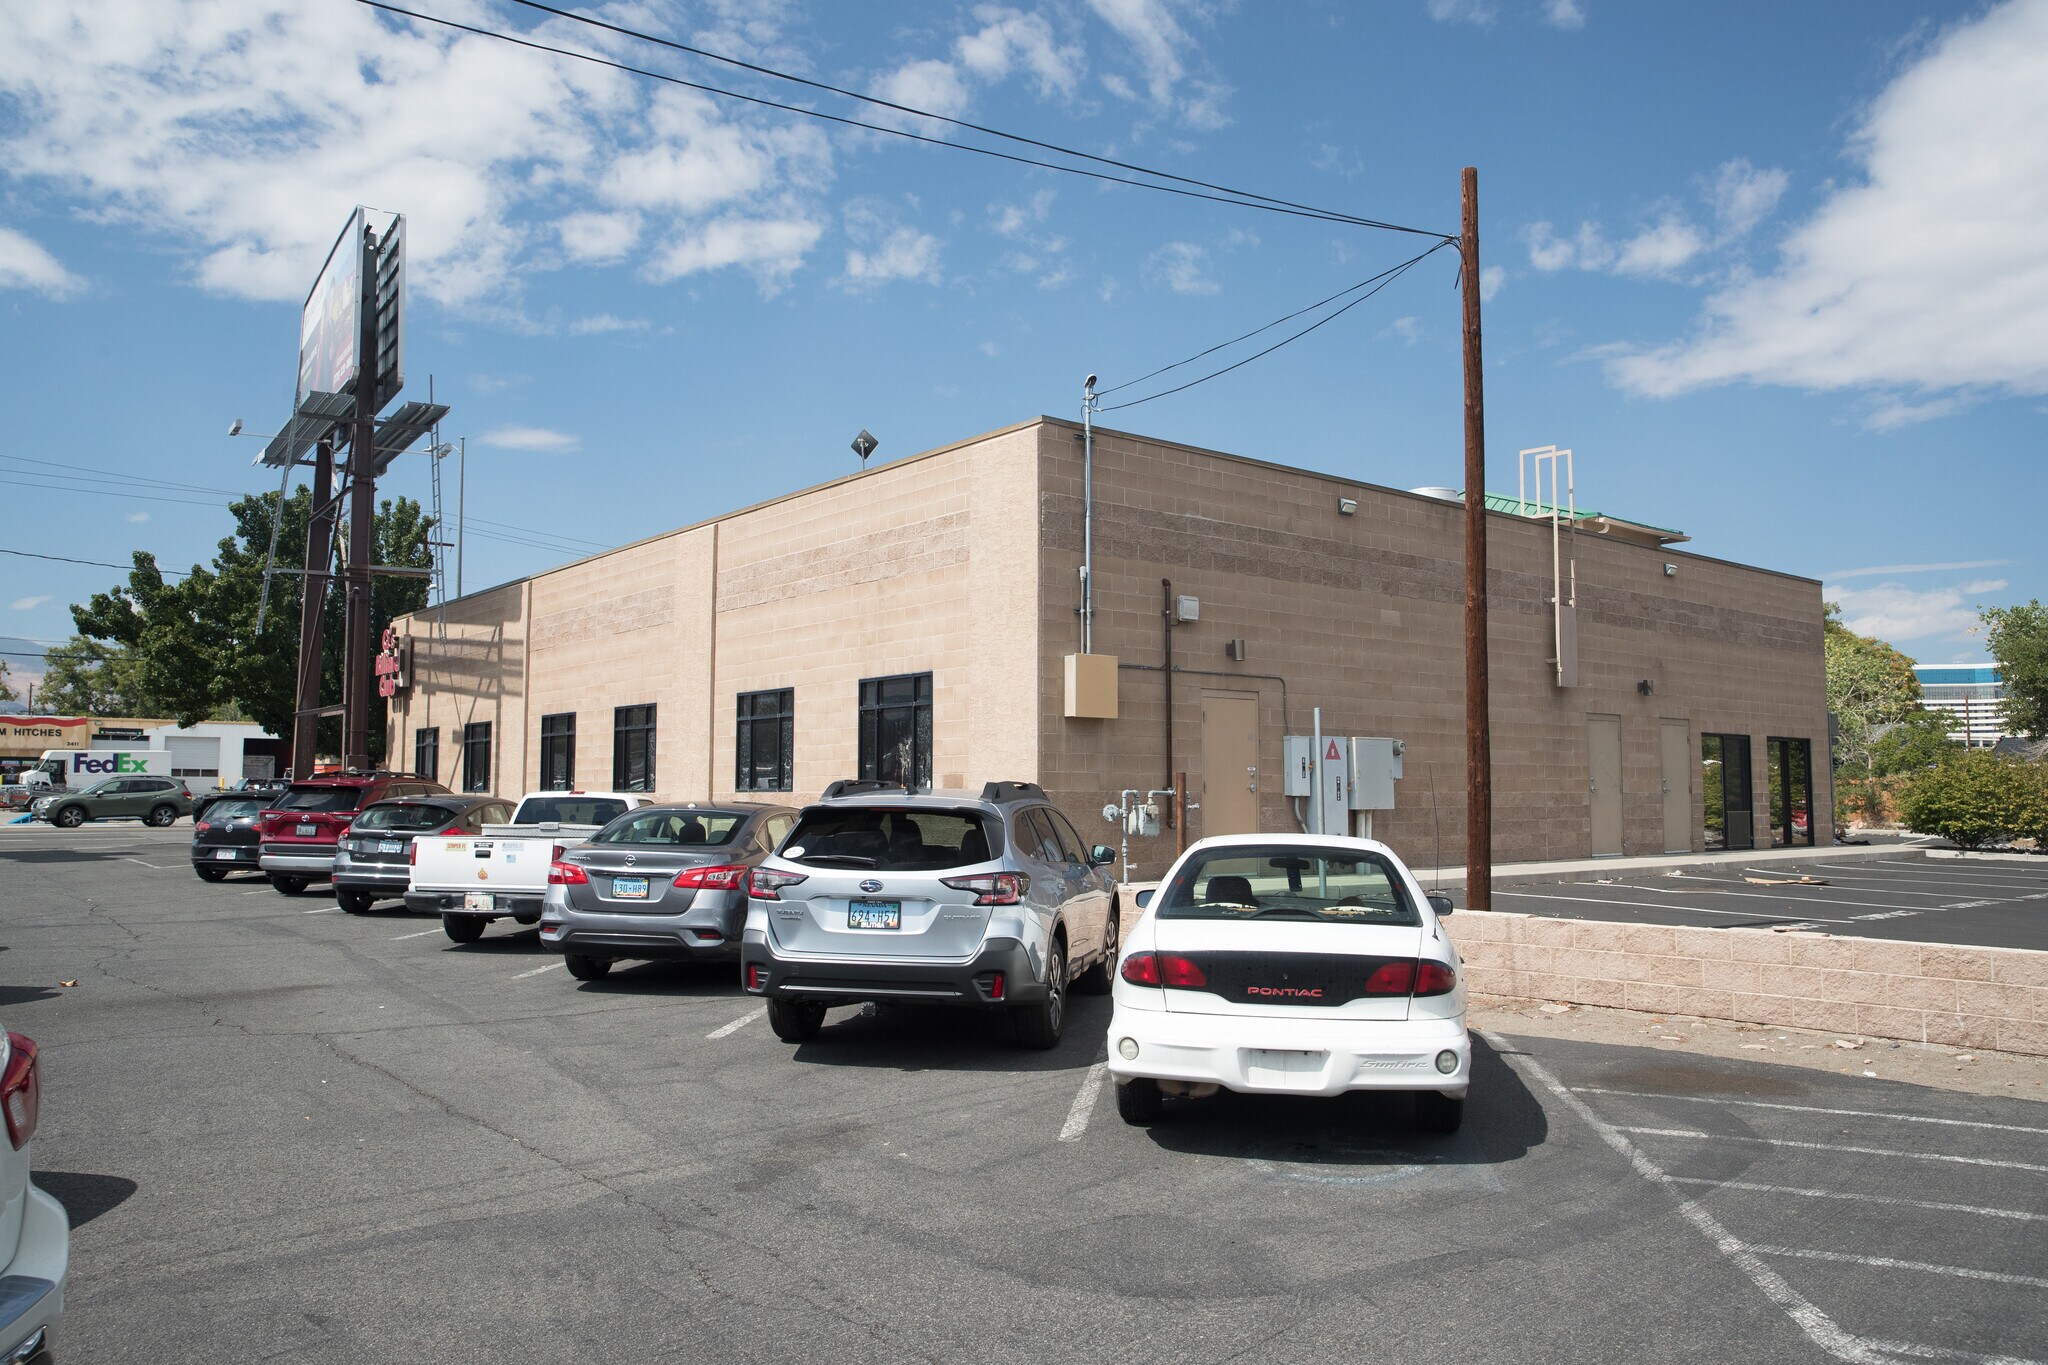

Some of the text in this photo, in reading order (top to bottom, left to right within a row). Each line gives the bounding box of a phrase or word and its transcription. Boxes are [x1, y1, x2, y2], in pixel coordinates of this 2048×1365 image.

[14, 728, 63, 737] HITCHES
[74, 753, 149, 774] FedEx
[1247, 986, 1324, 998] PONTIAC
[1358, 1060, 1430, 1069] Sunfire
